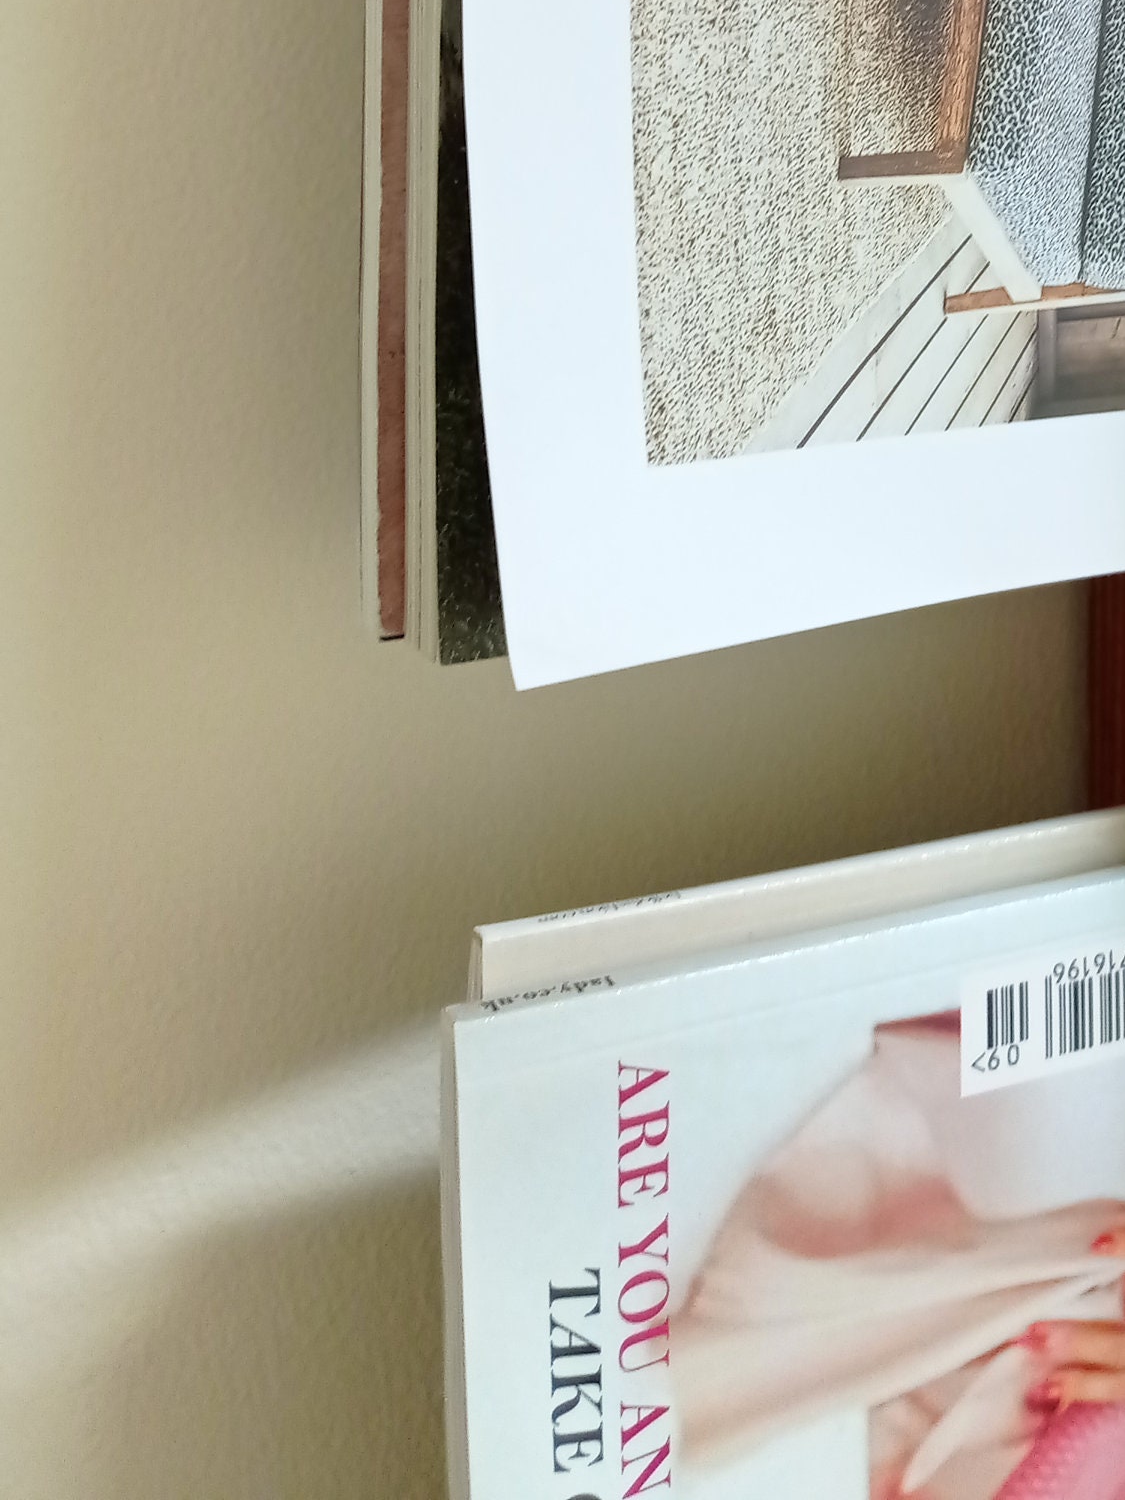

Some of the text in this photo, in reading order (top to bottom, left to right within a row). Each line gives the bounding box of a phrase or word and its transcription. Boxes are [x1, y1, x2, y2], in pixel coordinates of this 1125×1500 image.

[617, 1060, 670, 1208] ARE
[548, 1267, 604, 1473] TAKE
[617, 1212, 671, 1374] YOU
